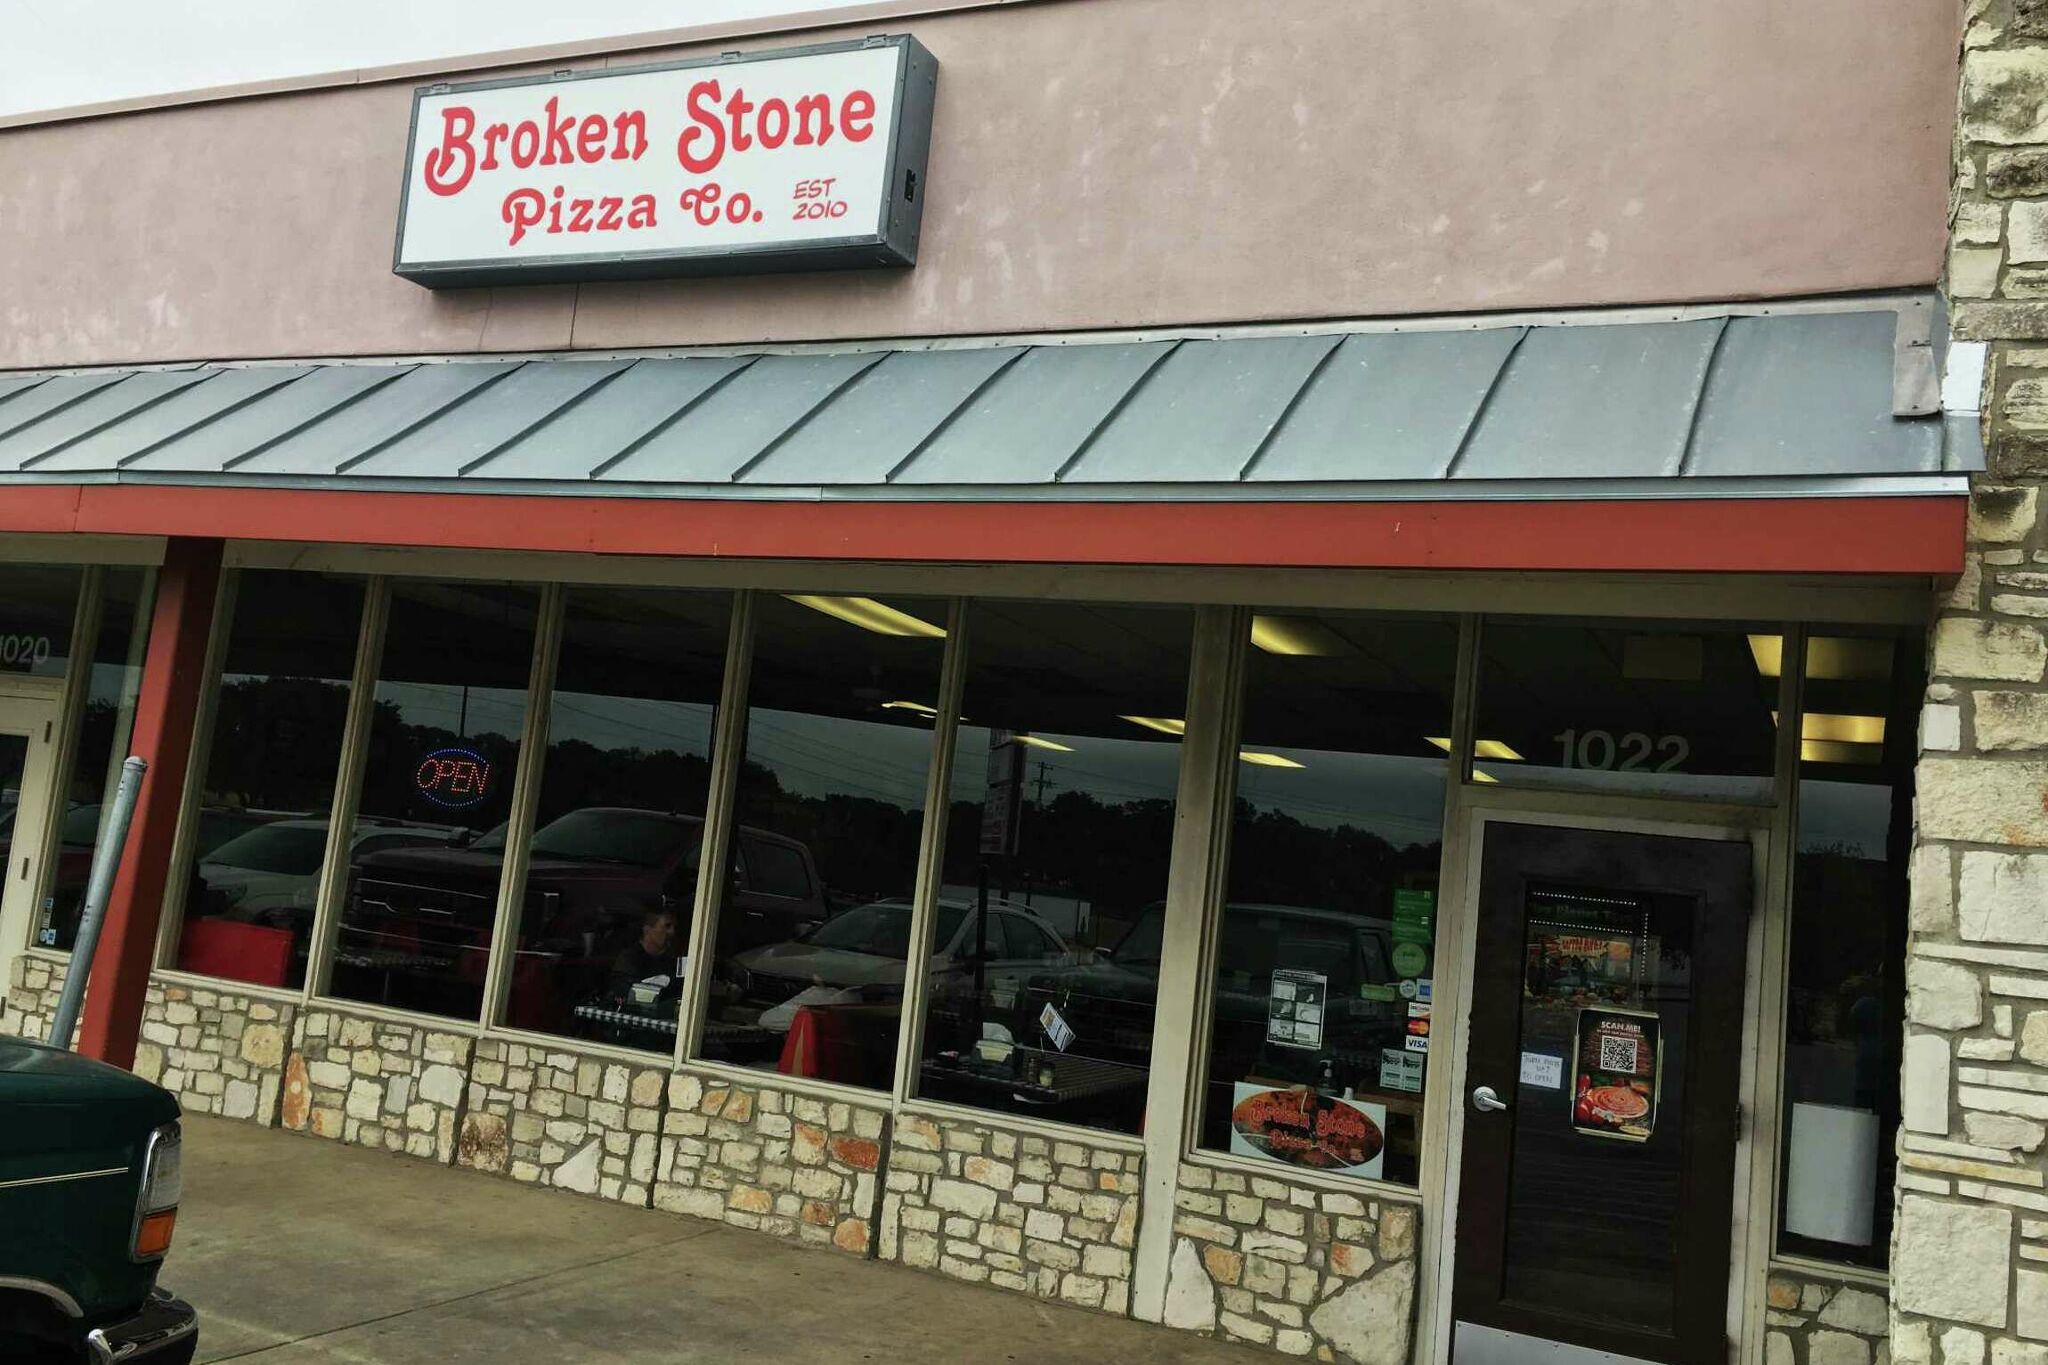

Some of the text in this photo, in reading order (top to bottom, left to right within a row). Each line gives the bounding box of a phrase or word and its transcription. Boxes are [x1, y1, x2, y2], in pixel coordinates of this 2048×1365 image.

[424, 79, 875, 196] Broken Stone
[793, 178, 836, 200] EST
[501, 182, 763, 246] Pizza Co.
[792, 200, 848, 221] 2010
[1553, 729, 1690, 775] 1022
[416, 759, 490, 794] OPEN
[1408, 1038, 1428, 1049] VISA
[1316, 1109, 1366, 1139] Stone
